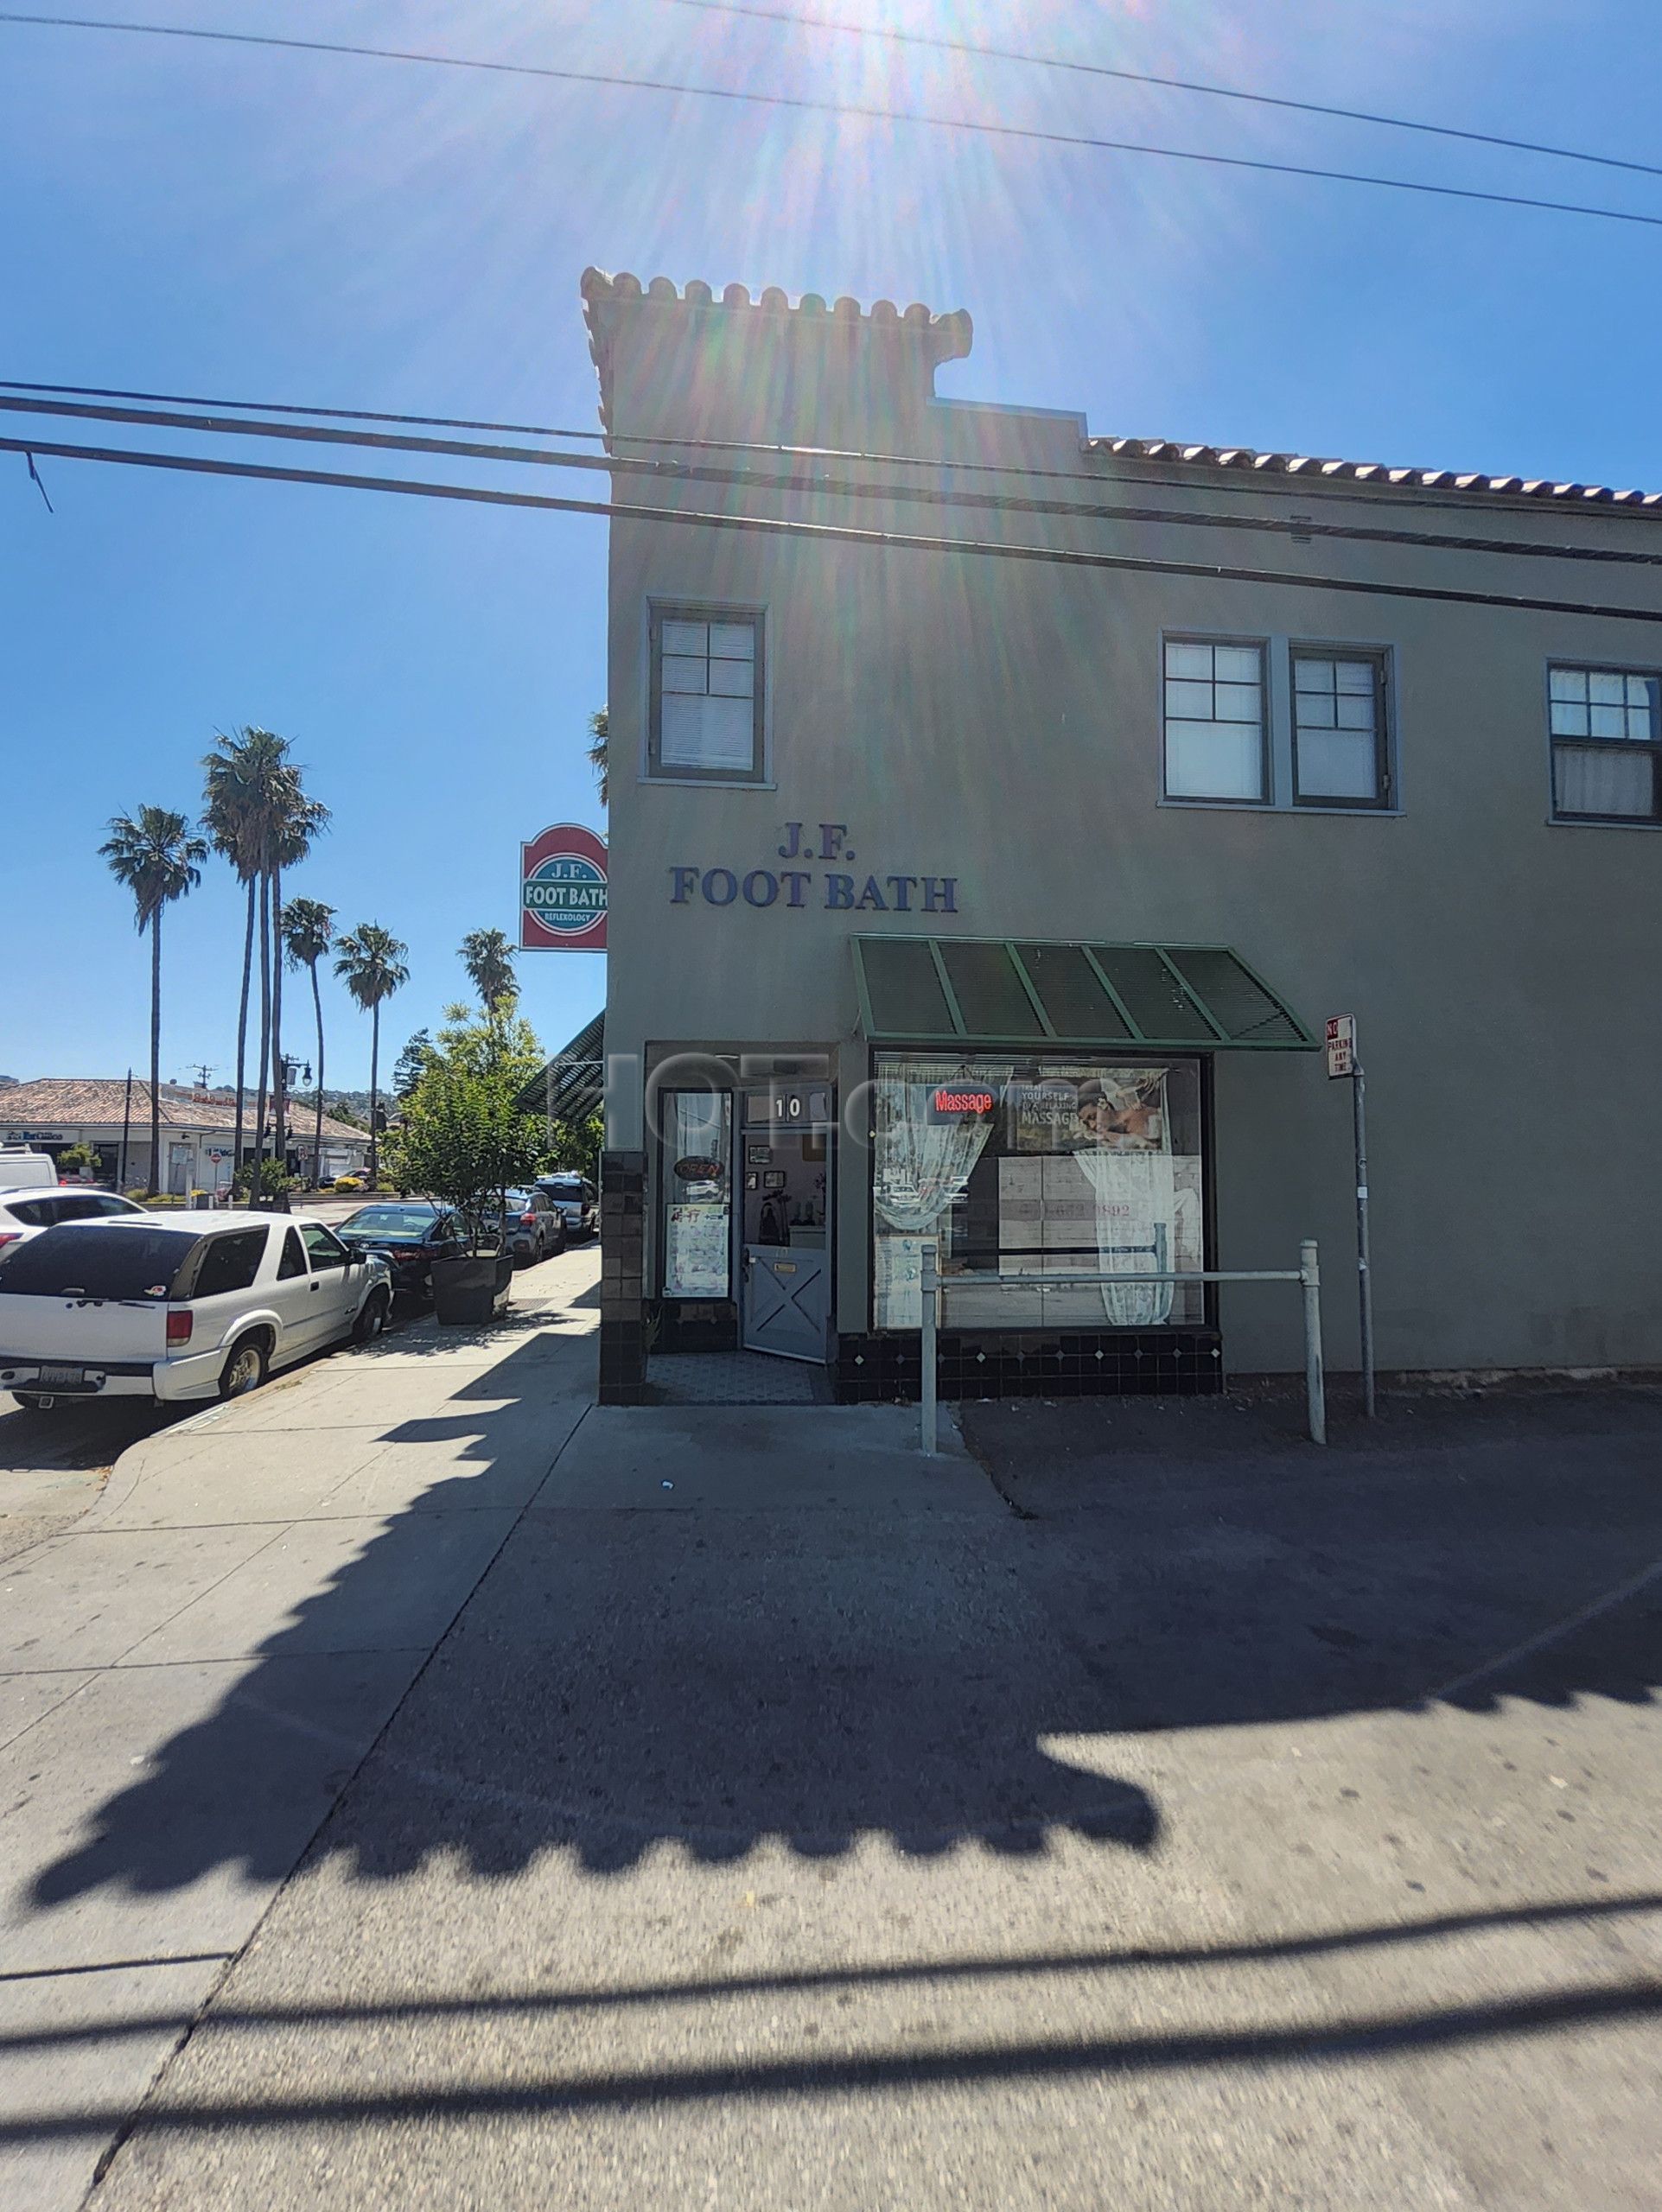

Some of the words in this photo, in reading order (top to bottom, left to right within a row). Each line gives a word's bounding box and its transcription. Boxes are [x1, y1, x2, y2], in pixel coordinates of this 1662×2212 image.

[779, 822, 856, 861] J.F.
[551, 863, 587, 880] J.F.
[525, 886, 567, 906] FOOT
[569, 887, 608, 906] BATH
[669, 867, 812, 907] FOOT
[825, 874, 958, 913] BATH
[544, 912, 591, 922] REFLEXOLOGY
[1328, 1021, 1337, 1036] NO
[1334, 1051, 1347, 1061] ANY
[935, 1090, 992, 1114] Massage
[1022, 1091, 1070, 1101] YOURSELF
[776, 1099, 800, 1117] 10
[1022, 1111, 1078, 1125] MASSAGE
[676, 1163, 720, 1176] OPEN
